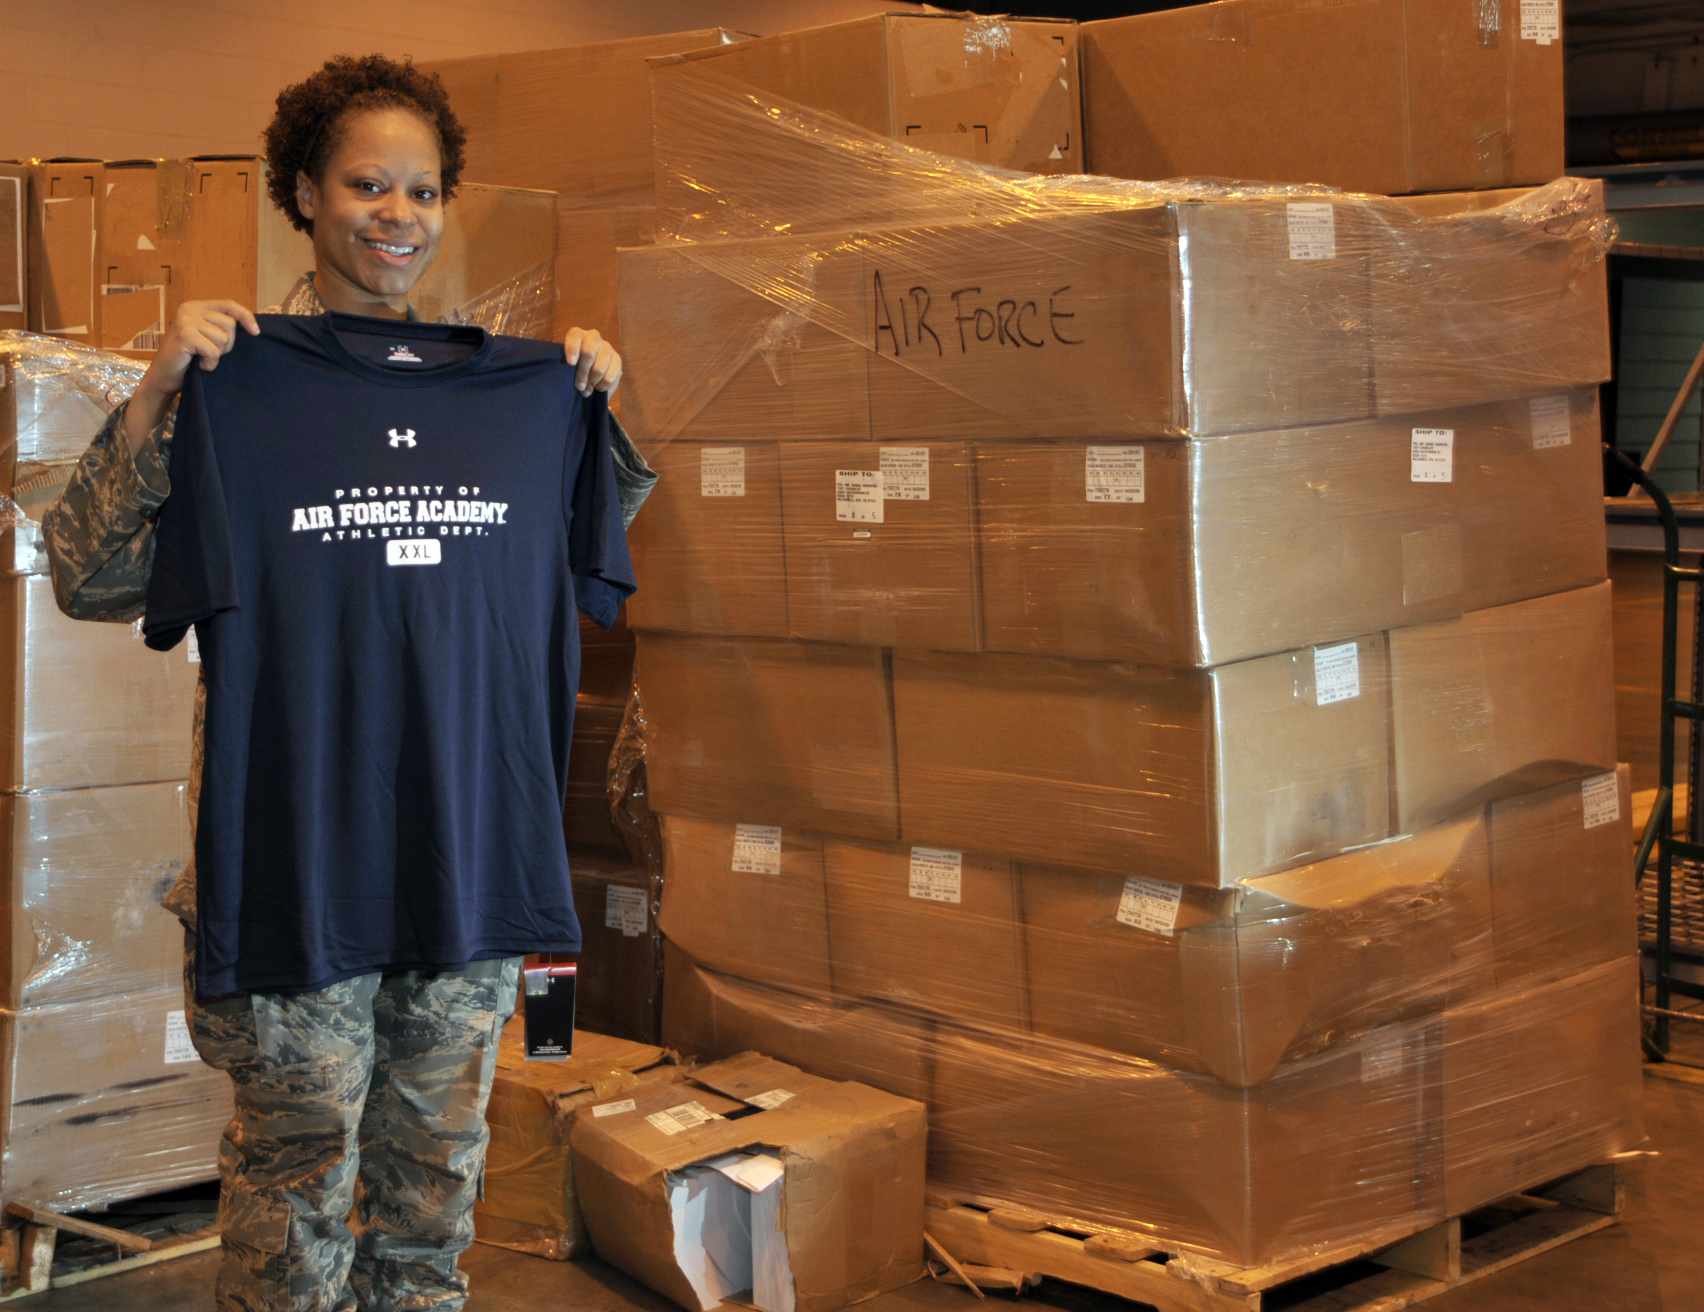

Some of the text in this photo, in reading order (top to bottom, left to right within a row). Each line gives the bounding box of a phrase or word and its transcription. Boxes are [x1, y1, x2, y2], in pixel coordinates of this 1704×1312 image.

[873, 269, 1085, 357] AIR FORCE
[335, 485, 480, 499] PROPERTY OF
[292, 500, 509, 531] AIR FORCE ACADEMY
[322, 526, 489, 541] ATHLETIC DEPT.
[399, 544, 432, 559] XXL
